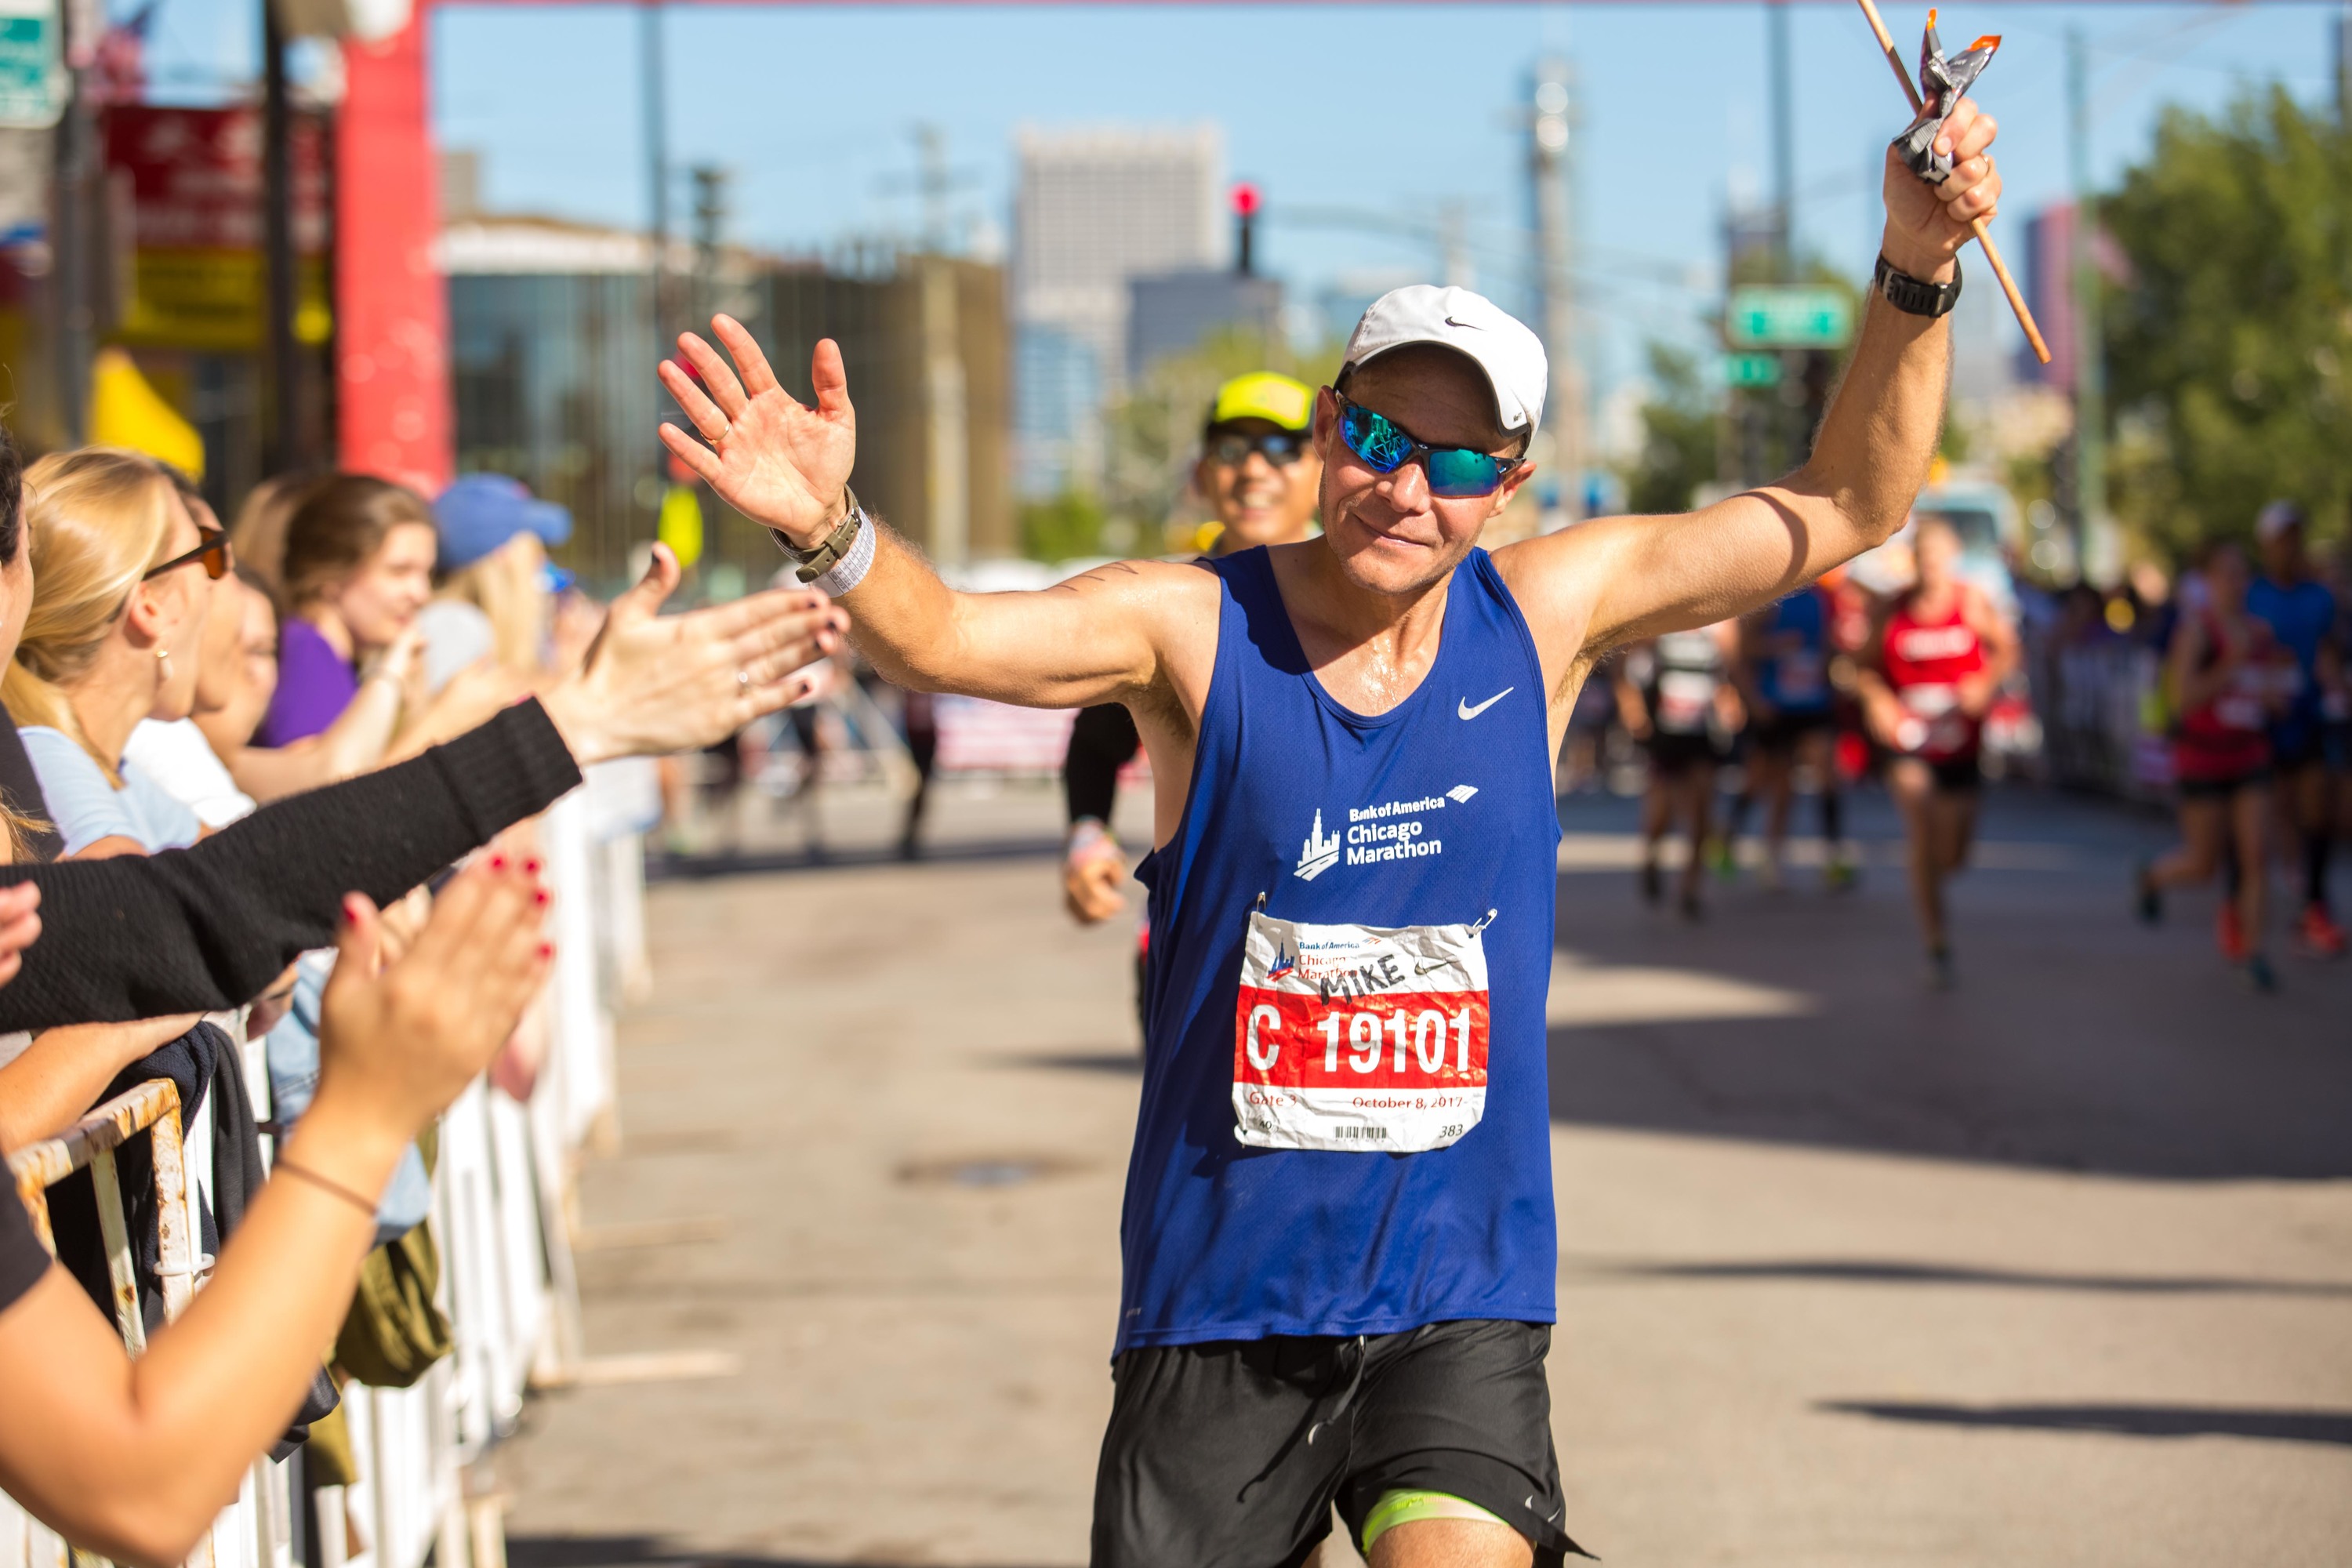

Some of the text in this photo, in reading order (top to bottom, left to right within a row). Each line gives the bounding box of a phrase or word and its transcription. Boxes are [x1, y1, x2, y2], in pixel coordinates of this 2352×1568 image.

[1377, 803, 1391, 818] of
[1392, 796, 1445, 815] America
[1347, 821, 1422, 844] Chicago
[1347, 840, 1442, 866] Marathon
[1321, 942, 1329, 950] of
[1320, 954, 1406, 1007] MIKE
[1247, 1004, 1471, 1073] C 19101
[1250, 1091, 1283, 1106] Gate
[1352, 1097, 1463, 1110] October 8, 2017
[1439, 1124, 1464, 1138] 383
